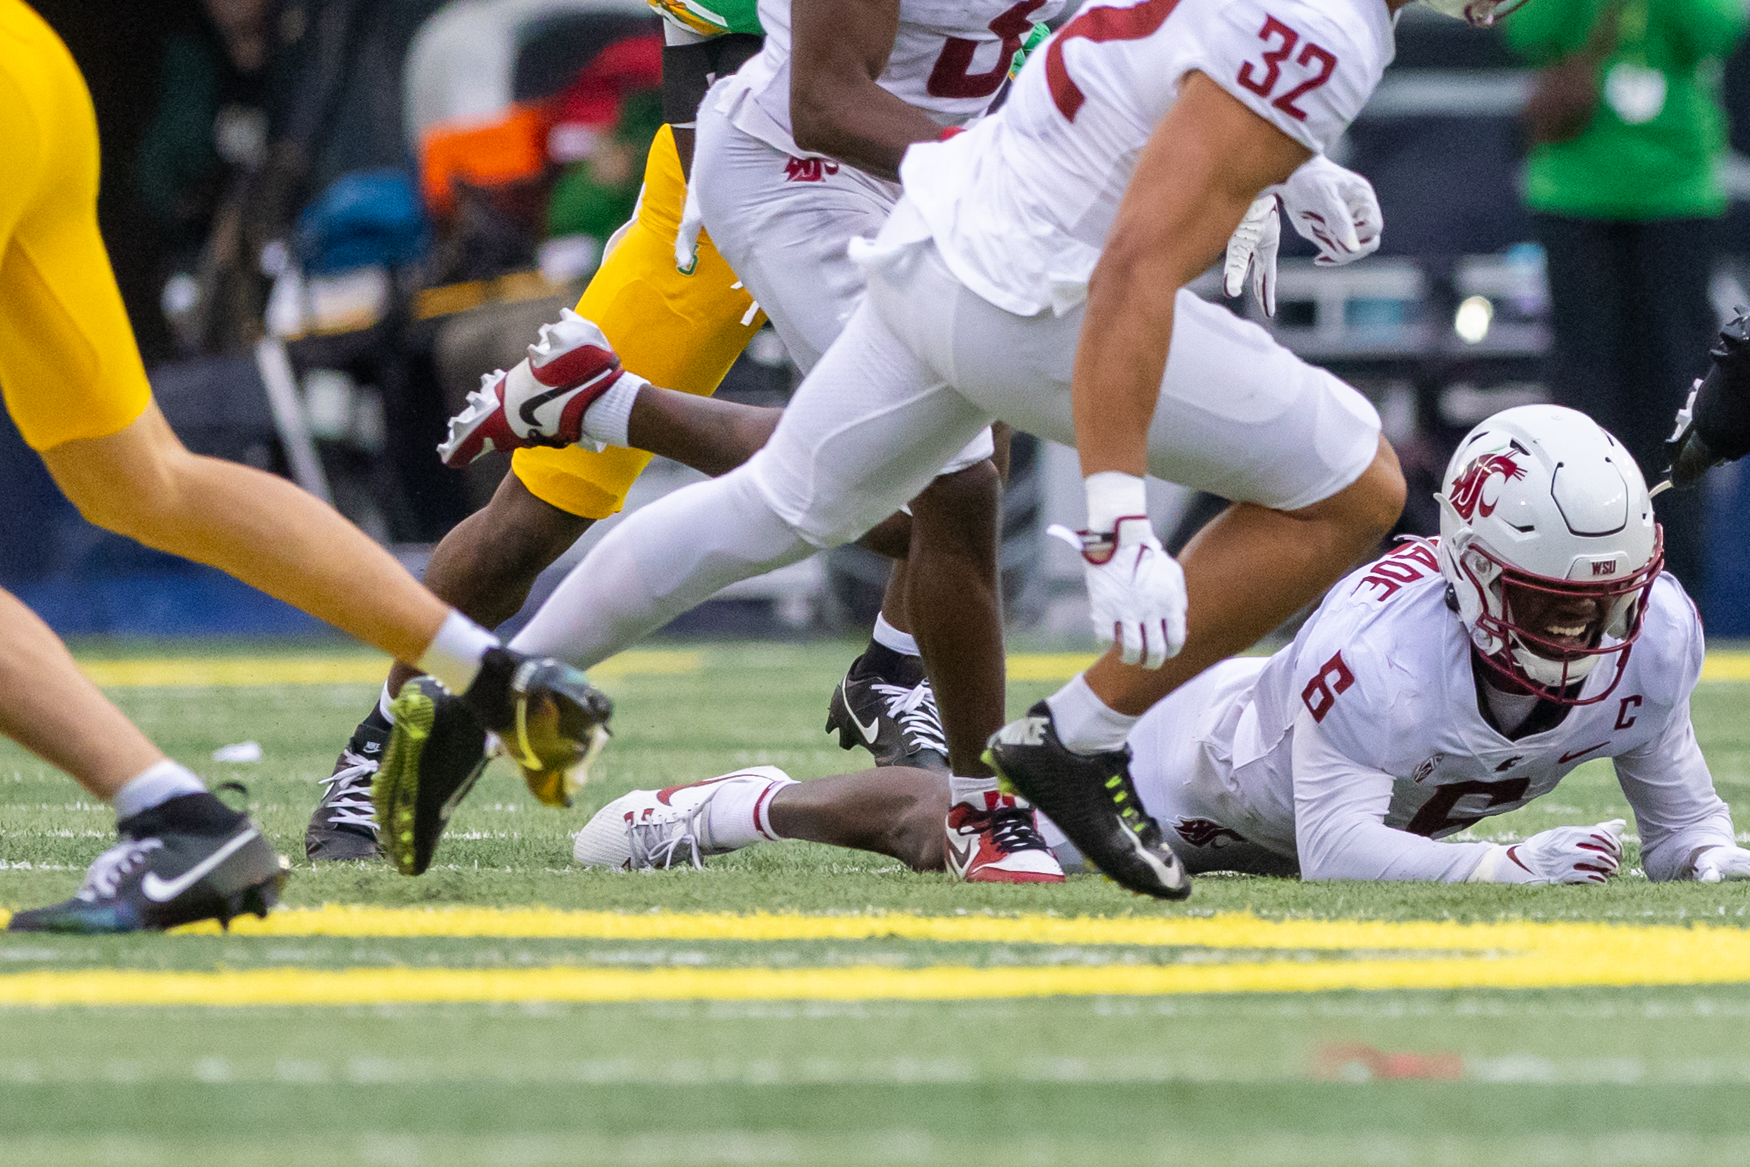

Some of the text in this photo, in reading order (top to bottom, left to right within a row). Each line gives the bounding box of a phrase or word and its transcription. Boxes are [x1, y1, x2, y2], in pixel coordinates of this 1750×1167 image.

[1236, 12, 1338, 122] 32
[1591, 559, 1617, 576] WSU
[1300, 648, 1355, 725] 6
[1612, 694, 1643, 731] C
